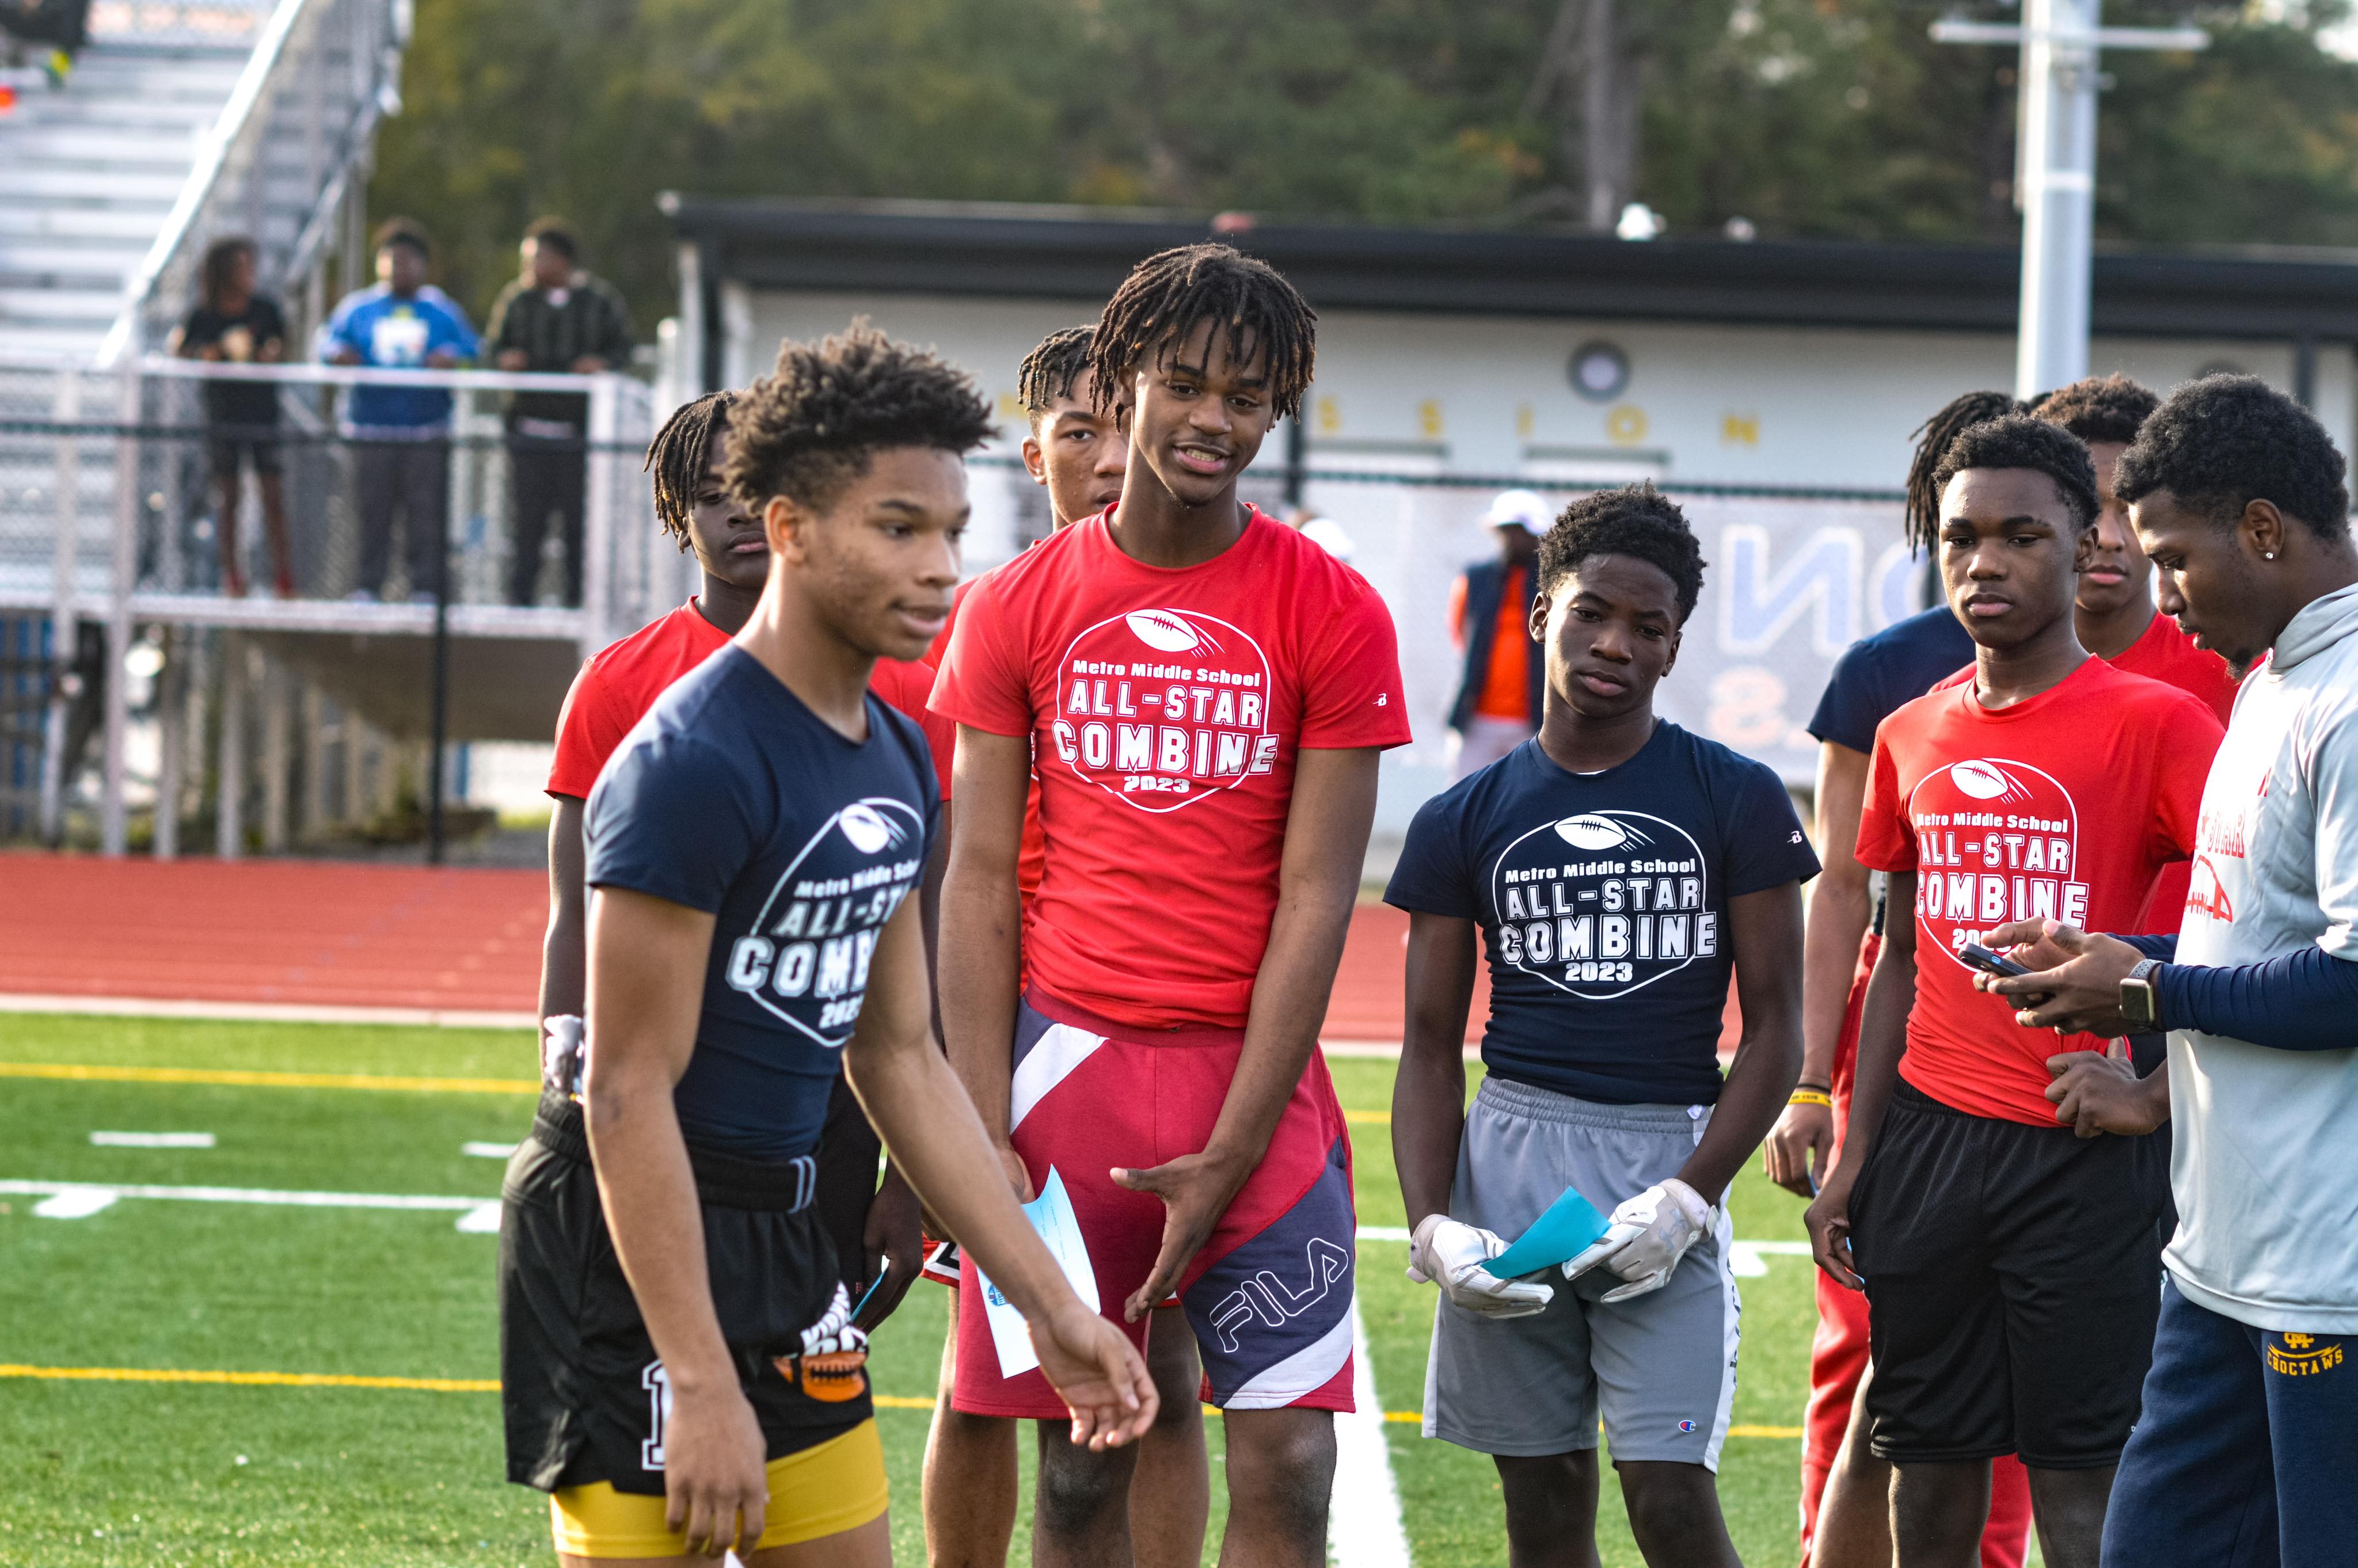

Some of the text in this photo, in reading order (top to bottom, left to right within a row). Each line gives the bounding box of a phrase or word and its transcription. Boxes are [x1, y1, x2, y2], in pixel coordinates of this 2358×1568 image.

[1072, 660, 1260, 687] Metro Middle School
[1067, 678, 1263, 728] ALL-STAR
[1051, 718, 1280, 778] COMBINE
[1124, 775, 1191, 794] 2023
[1916, 812, 2068, 833] Metro Middle School
[1505, 858, 1695, 883] Metro Middle School
[1920, 831, 2071, 874] ALL-STAR
[794, 859, 921, 897] Metro Middle Sch
[1505, 877, 1701, 920] ALL-STAR
[770, 884, 911, 938] ALL-ST
[1917, 870, 2089, 931] COMBINE
[1499, 911, 1717, 965] COMBINE
[725, 927, 881, 998] COMB
[1565, 962, 1633, 981] 2023
[819, 992, 864, 1029] 202
[1210, 1238, 1348, 1353] FILA
[2267, 1349, 2343, 1376] CHOCTAWS
